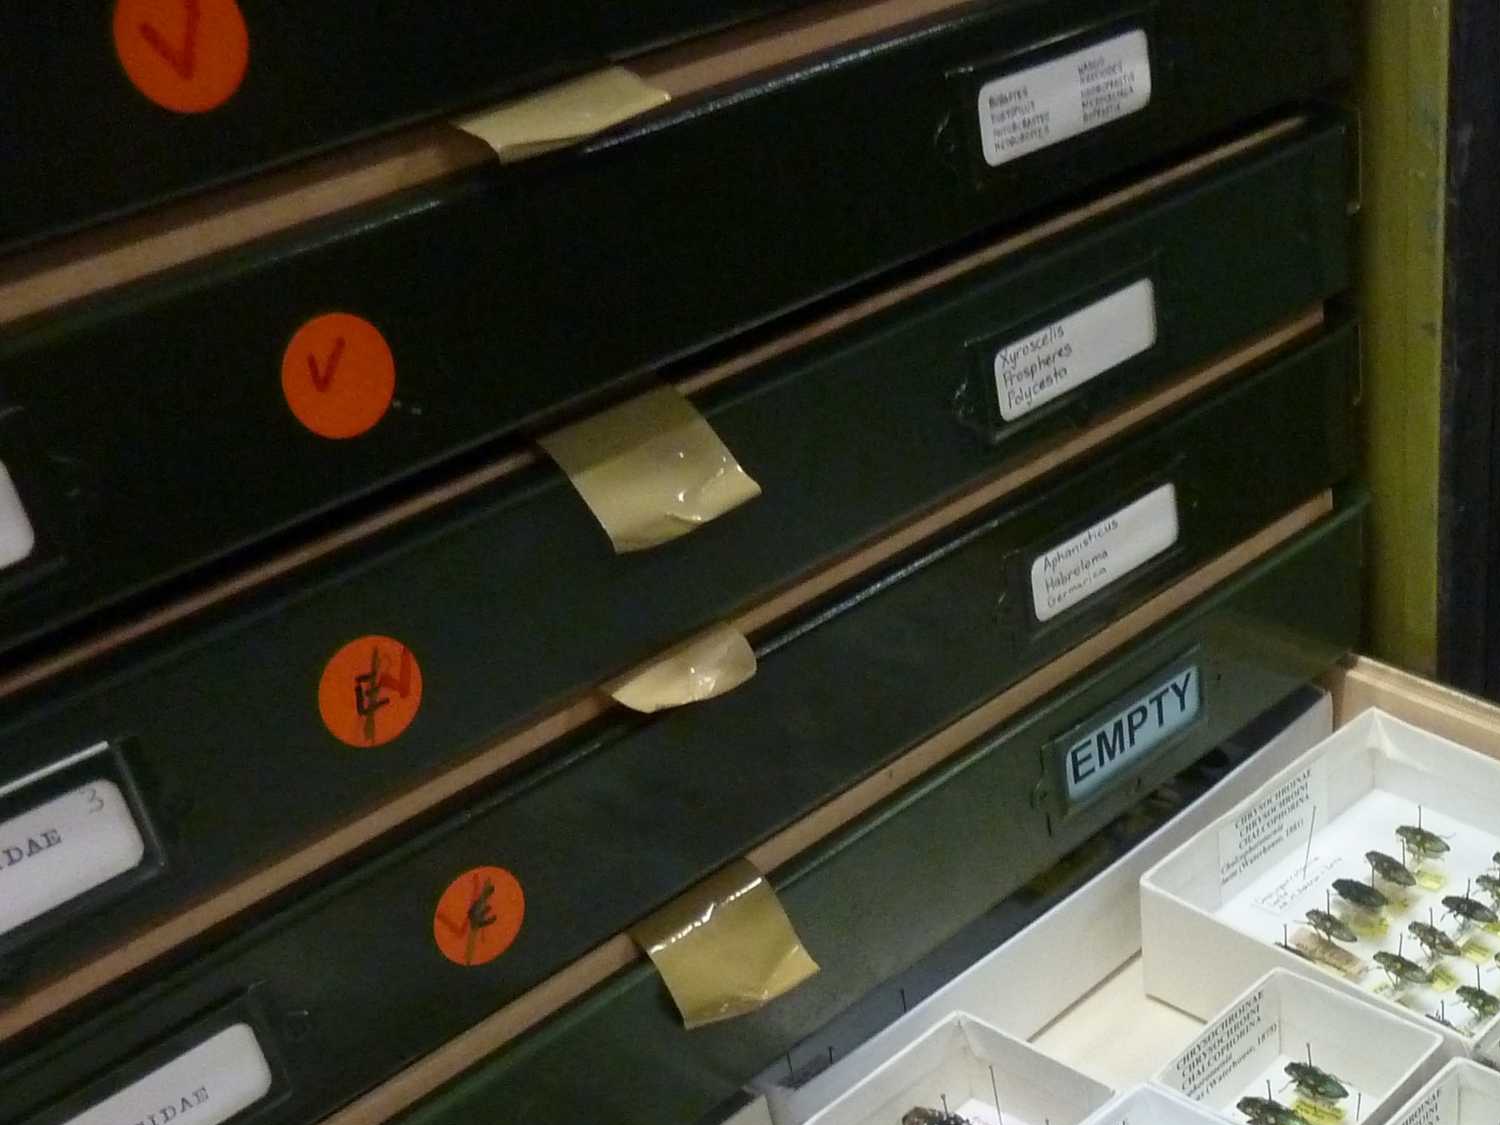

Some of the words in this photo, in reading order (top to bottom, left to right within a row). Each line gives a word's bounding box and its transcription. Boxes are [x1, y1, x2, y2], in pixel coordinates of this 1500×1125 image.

[1001, 325, 1064, 369] Xyroscelis
[1008, 367, 1068, 409] Polycesta
[1043, 518, 1118, 572] Aphanisticus
[1070, 672, 1192, 784] EMPTY
[0, 828, 62, 870] DAE
